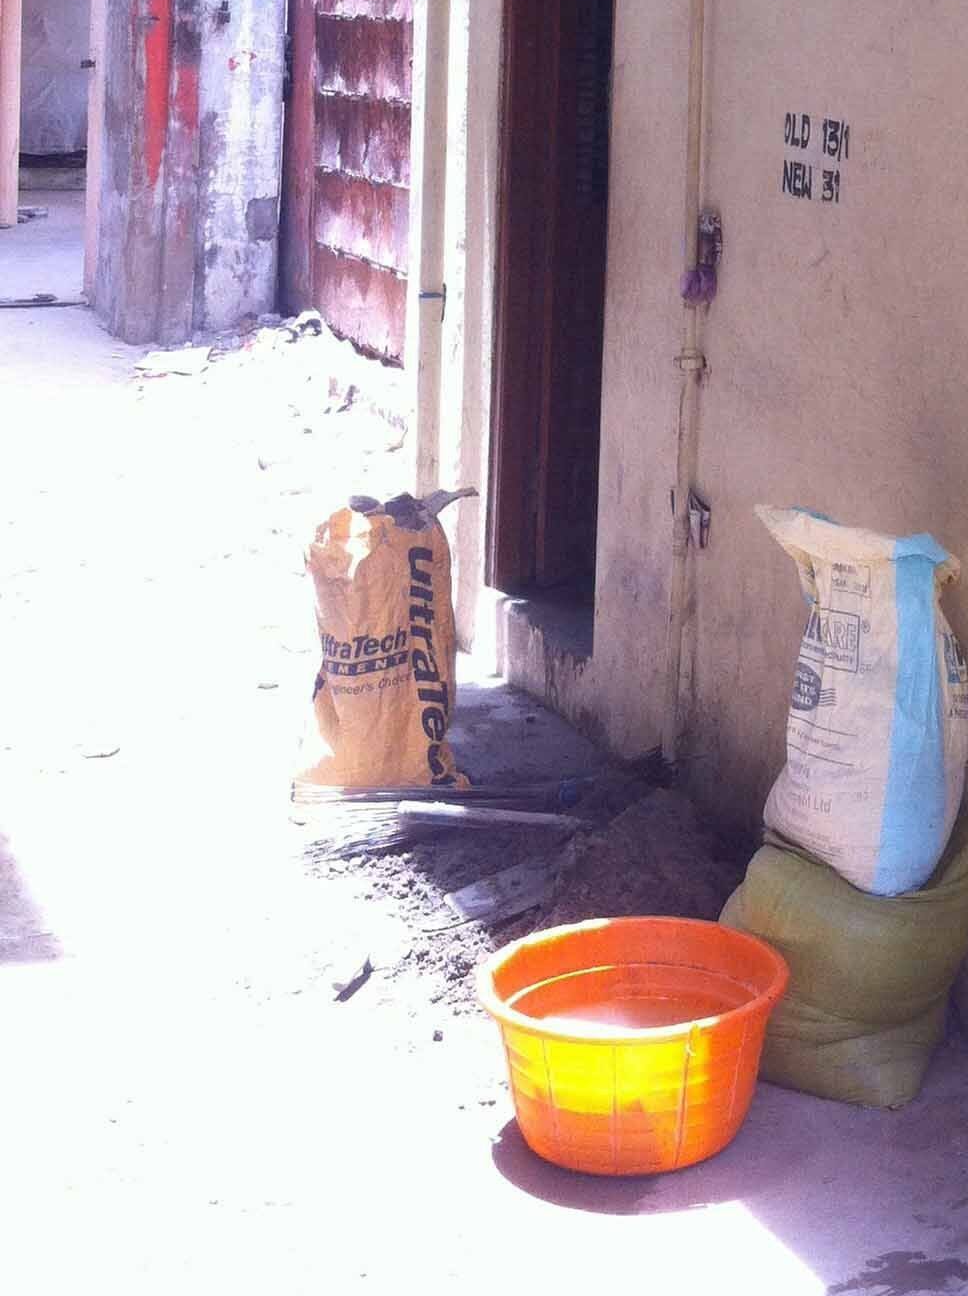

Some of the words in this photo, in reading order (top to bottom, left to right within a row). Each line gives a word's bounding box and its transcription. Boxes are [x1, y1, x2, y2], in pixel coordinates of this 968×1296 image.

[784, 112, 811, 149] OLD
[822, 118, 850, 162] 13/1
[782, 160, 812, 200] NEW
[822, 169, 840, 203] 31
